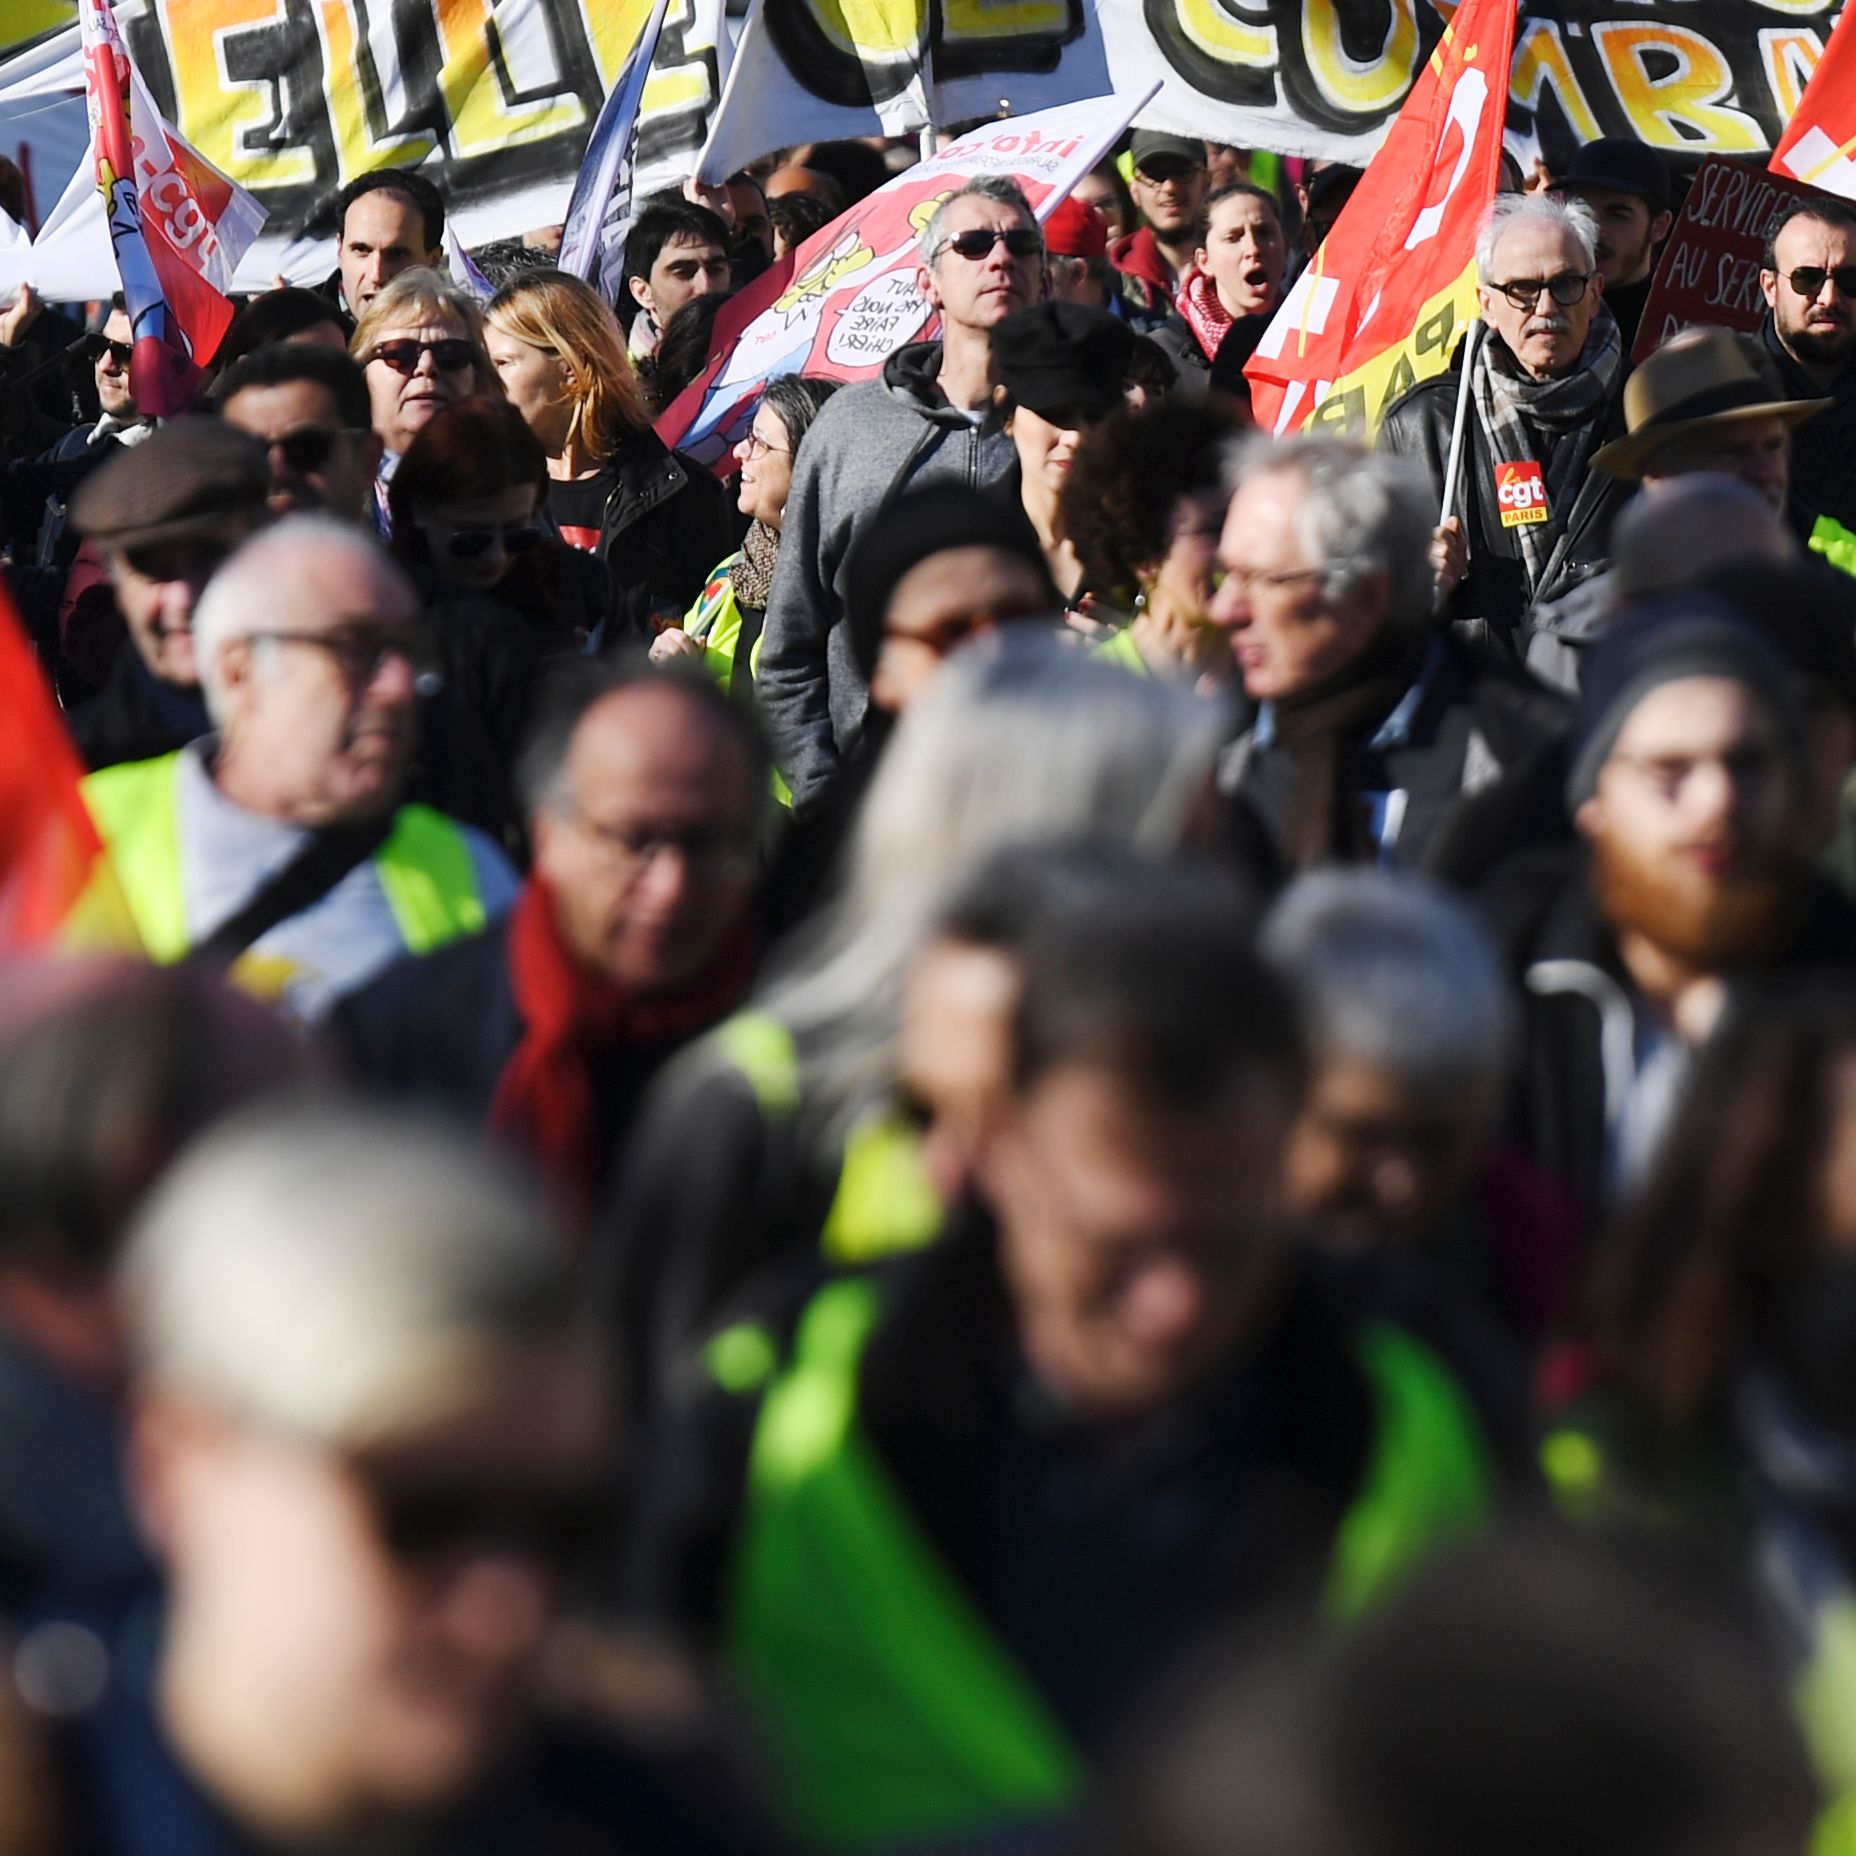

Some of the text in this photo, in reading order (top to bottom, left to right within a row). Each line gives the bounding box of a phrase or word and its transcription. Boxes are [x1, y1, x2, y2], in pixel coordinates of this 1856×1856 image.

[1664, 241, 1708, 289] AU
[1498, 475, 1544, 508] cgt
[1504, 508, 1544, 523] PARIS
